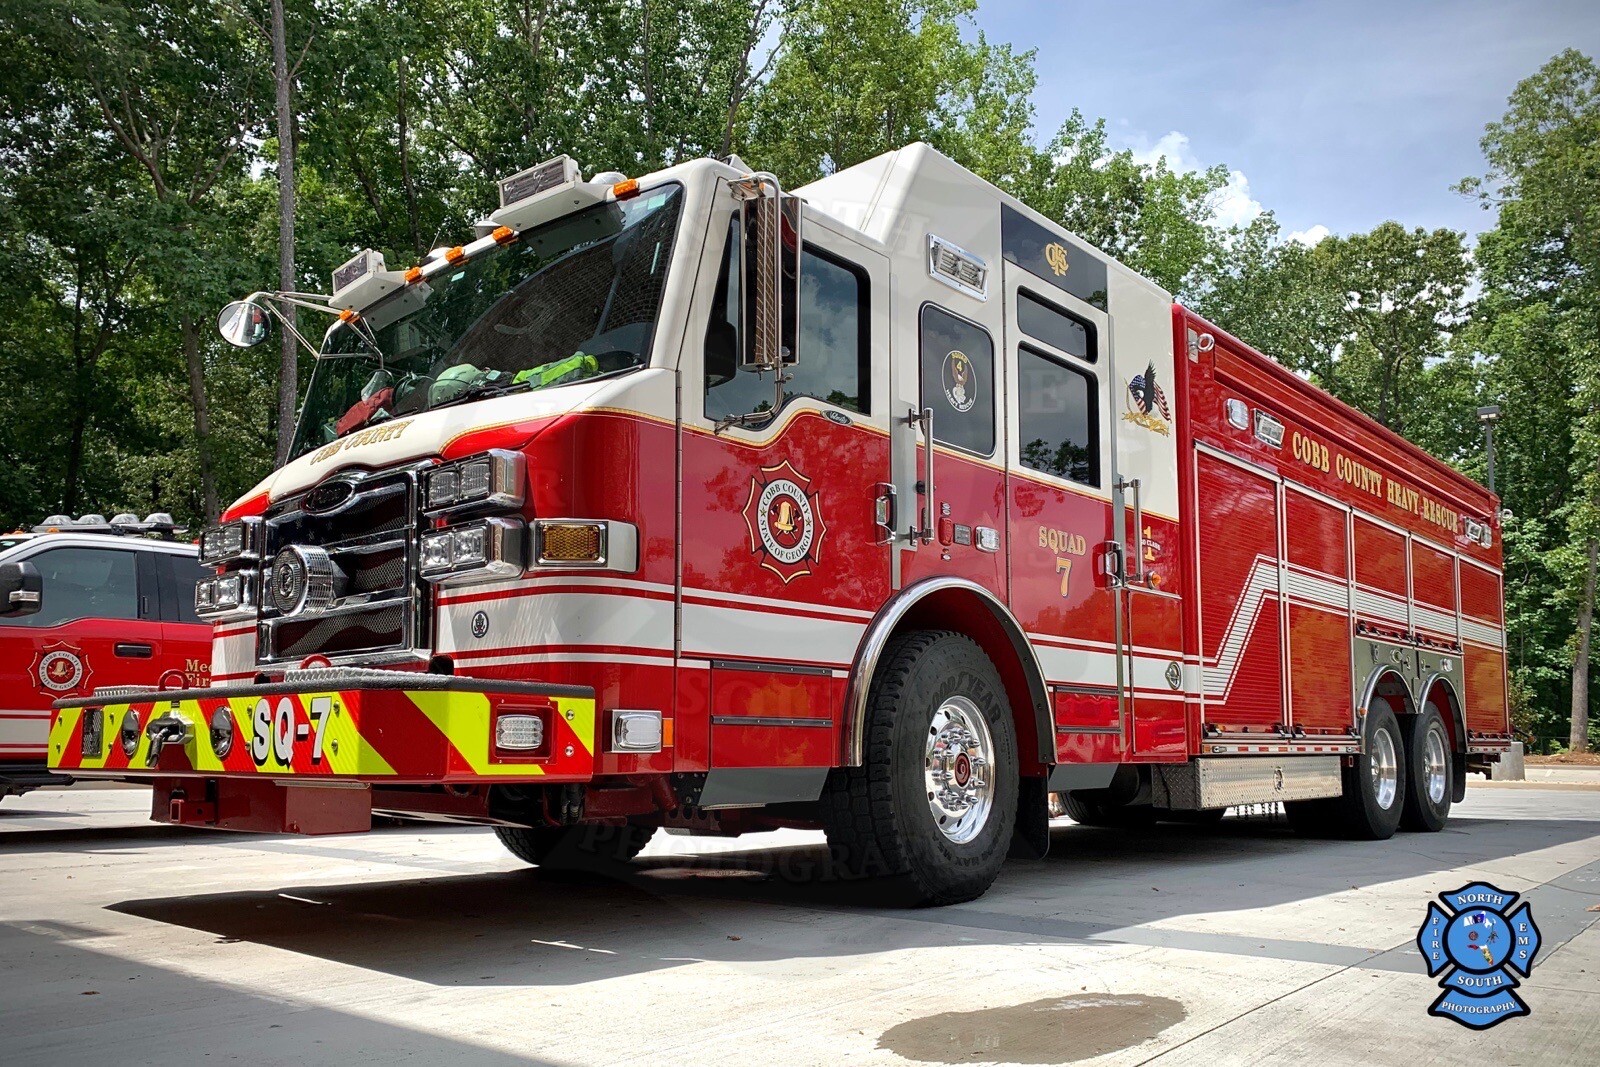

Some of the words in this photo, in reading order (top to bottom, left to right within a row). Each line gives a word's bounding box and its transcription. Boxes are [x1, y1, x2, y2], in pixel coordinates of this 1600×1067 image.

[956, 361, 963, 372] 4
[310, 438, 347, 465] COBB
[345, 419, 415, 450] COUNTY
[762, 483, 780, 506] COBB
[782, 483, 811, 515] COUNTY
[1292, 431, 1330, 473] COBB
[1336, 453, 1383, 498] COUNTY
[1386, 478, 1419, 515] HEAVY
[1422, 496, 1458, 534] RESCUE
[760, 519, 774, 551] STATE
[774, 547, 784, 558] OF
[785, 529, 811, 561] GEORGIA
[1038, 525, 1087, 556] SQUAD
[1056, 556, 1072, 598] 7
[252, 696, 332, 769] SQ-7
